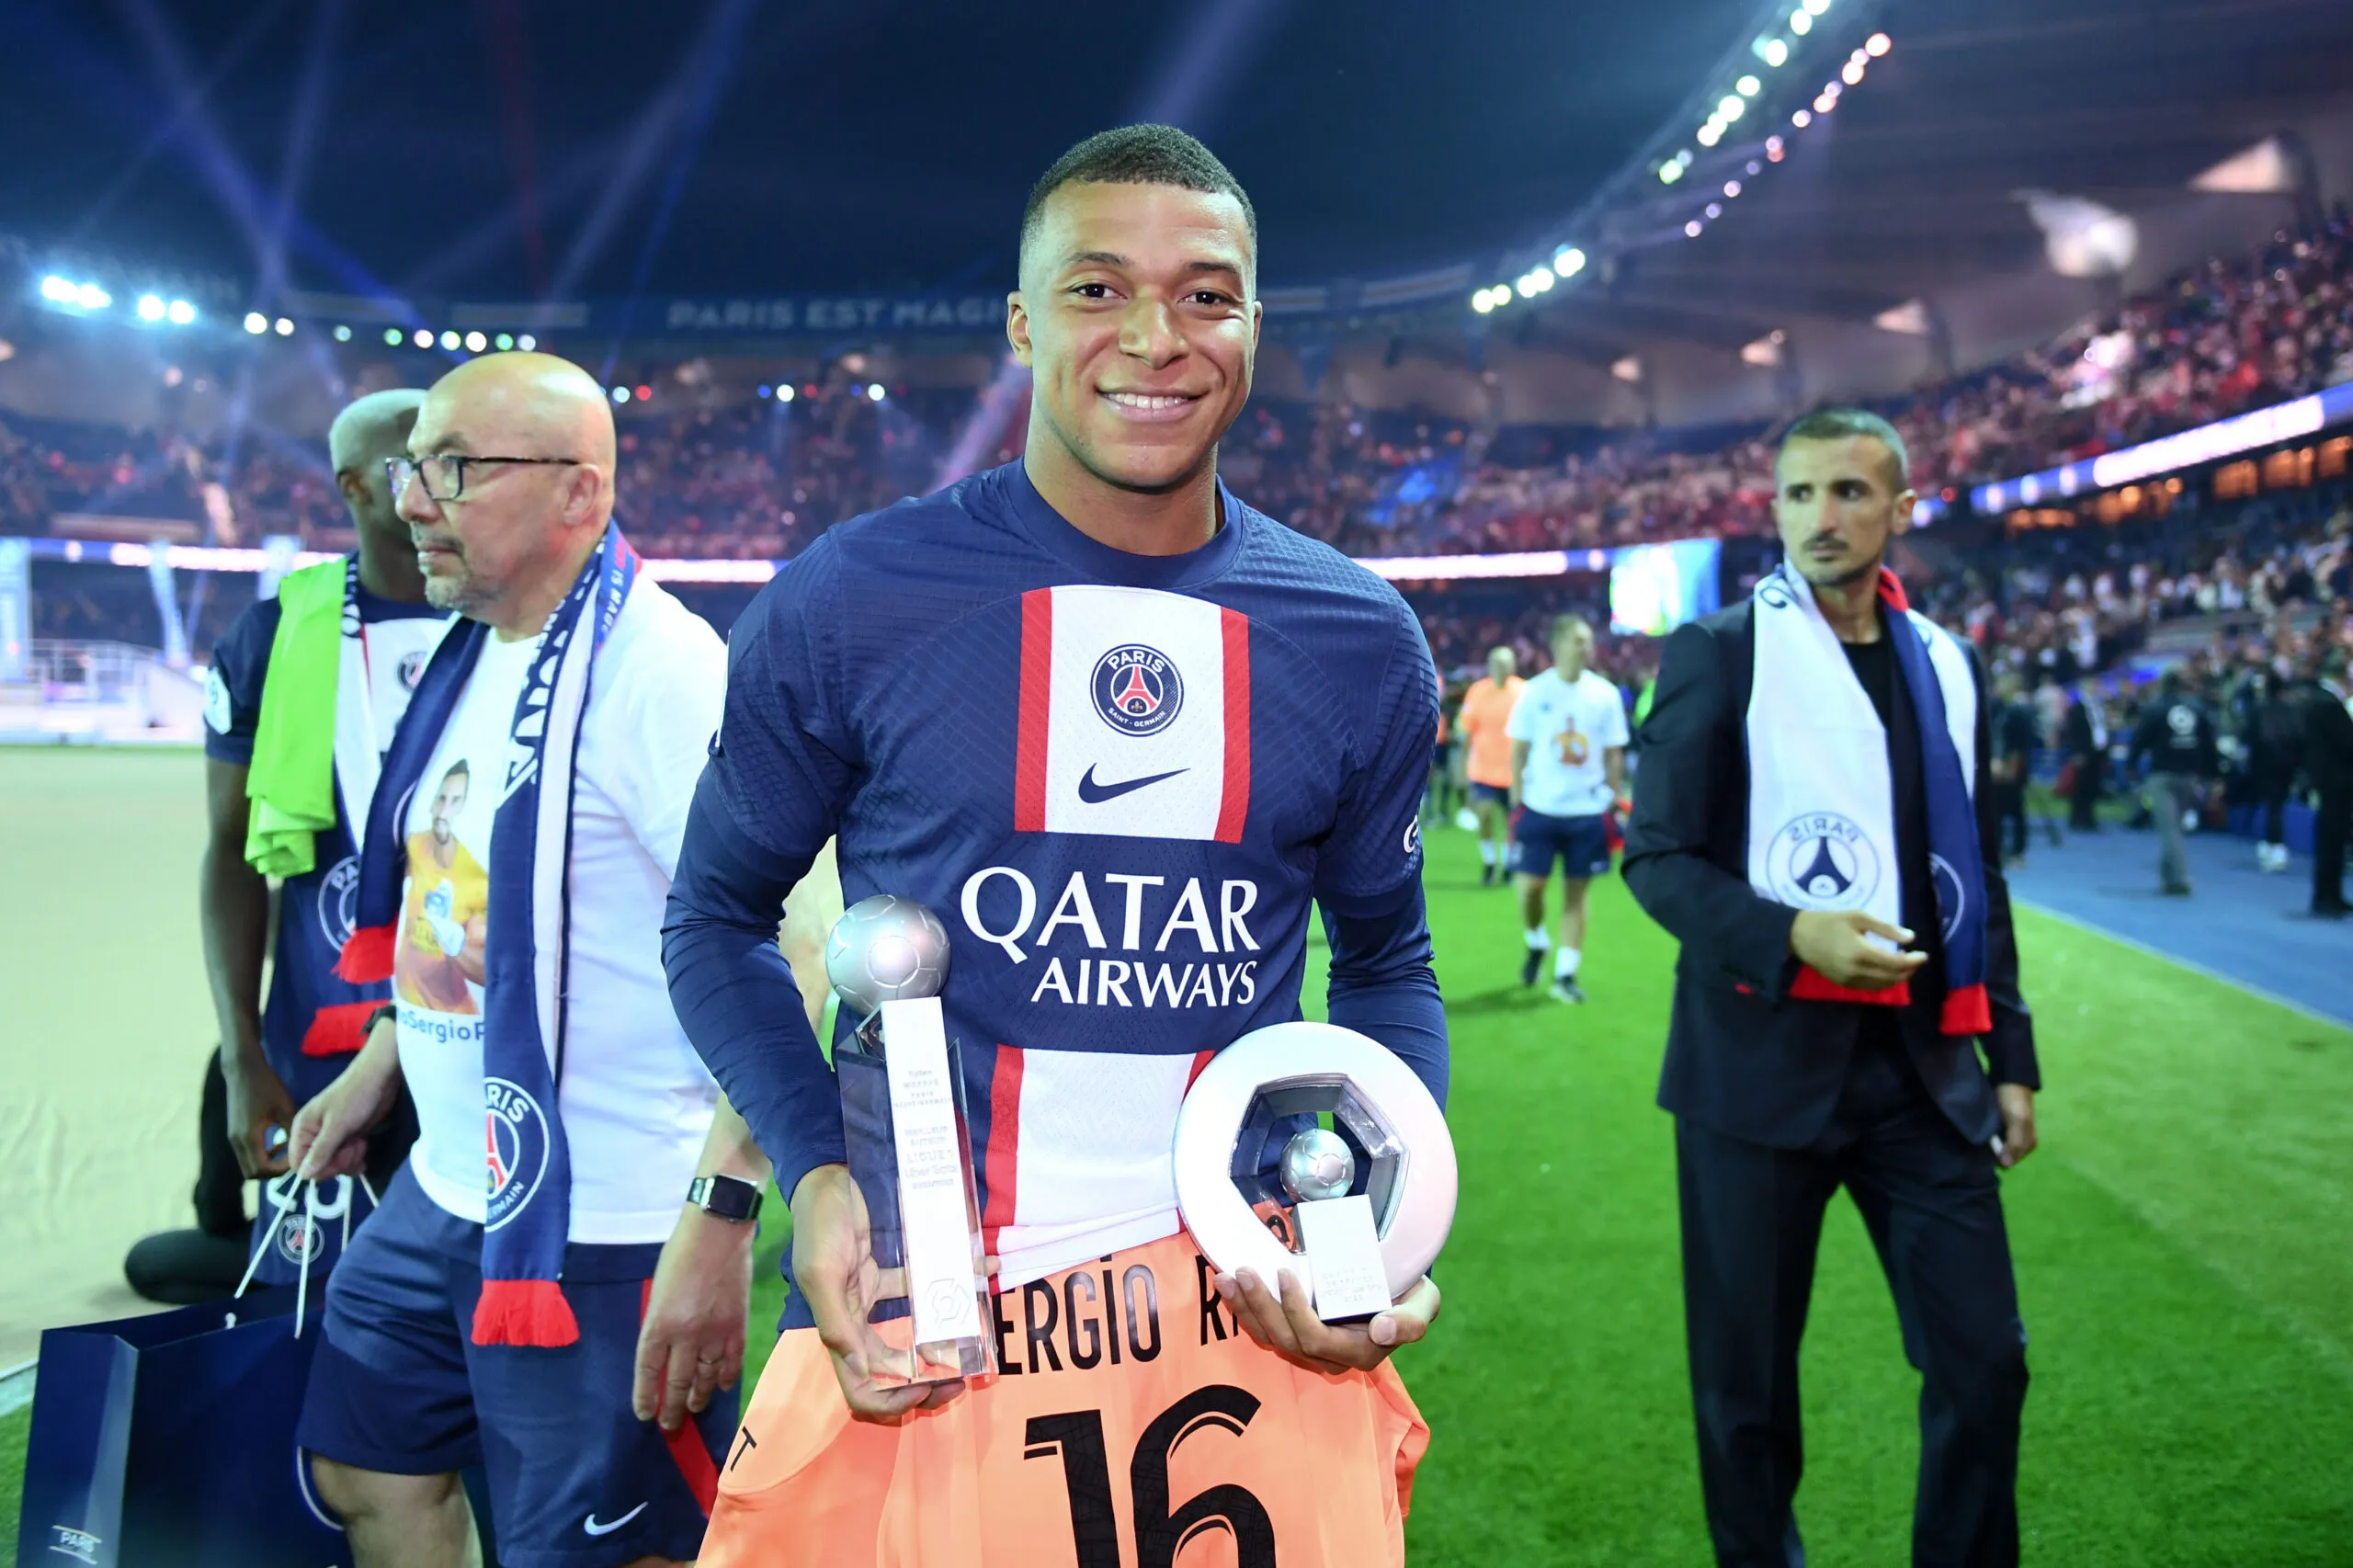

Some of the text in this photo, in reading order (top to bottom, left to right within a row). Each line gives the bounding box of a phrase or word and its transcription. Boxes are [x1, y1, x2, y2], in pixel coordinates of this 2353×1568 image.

[666, 300, 794, 329] PARIS
[805, 298, 885, 329] EST
[1108, 650, 1165, 673] PARIS
[961, 866, 1261, 964] QATAR
[1030, 957, 1257, 1008] AIRWAYS
[1023, 1383, 1277, 1568] 16
